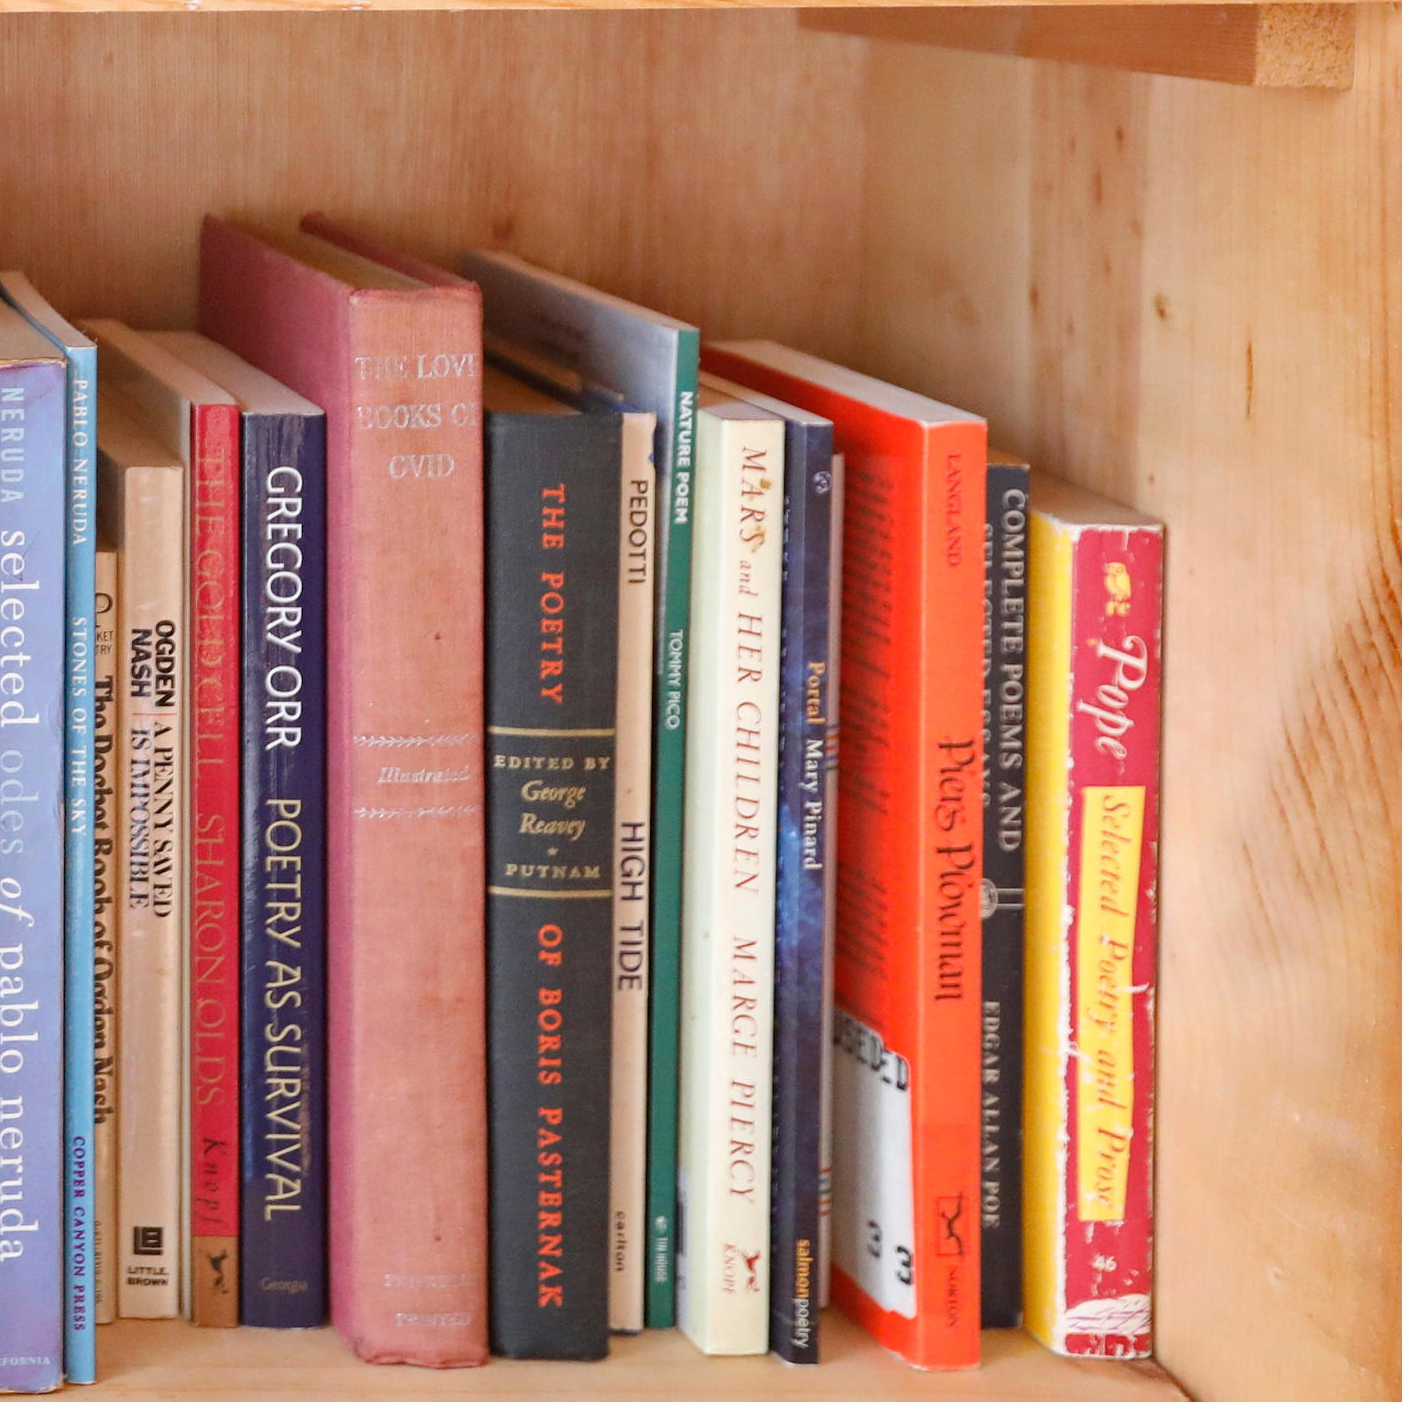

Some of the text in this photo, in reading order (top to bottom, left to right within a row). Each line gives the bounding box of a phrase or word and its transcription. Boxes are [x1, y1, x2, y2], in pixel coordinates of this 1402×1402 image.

[0, 531, 40, 727] selected
[130, 628, 151, 698] NASH
[155, 620, 175, 707] OGDEN
[266, 467, 302, 750] GREGORY ORR
[540, 484, 565, 702] THE POETRY
[1079, 635, 1147, 760] Pope
[0, 750, 39, 854] odes
[935, 739, 975, 1000] Piers Plowman
[619, 823, 644, 990] HIGH TIDE
[265, 799, 302, 1220] POETRY AS SURVIVAL
[0, 1096, 38, 1261] neruda
[539, 925, 562, 1308] OF BORIS PASTERNAK
[983, 1002, 1001, 1227] EDGAR ALLAN POE
[73, 1136, 85, 1330] COPPER CANYON PRESS
